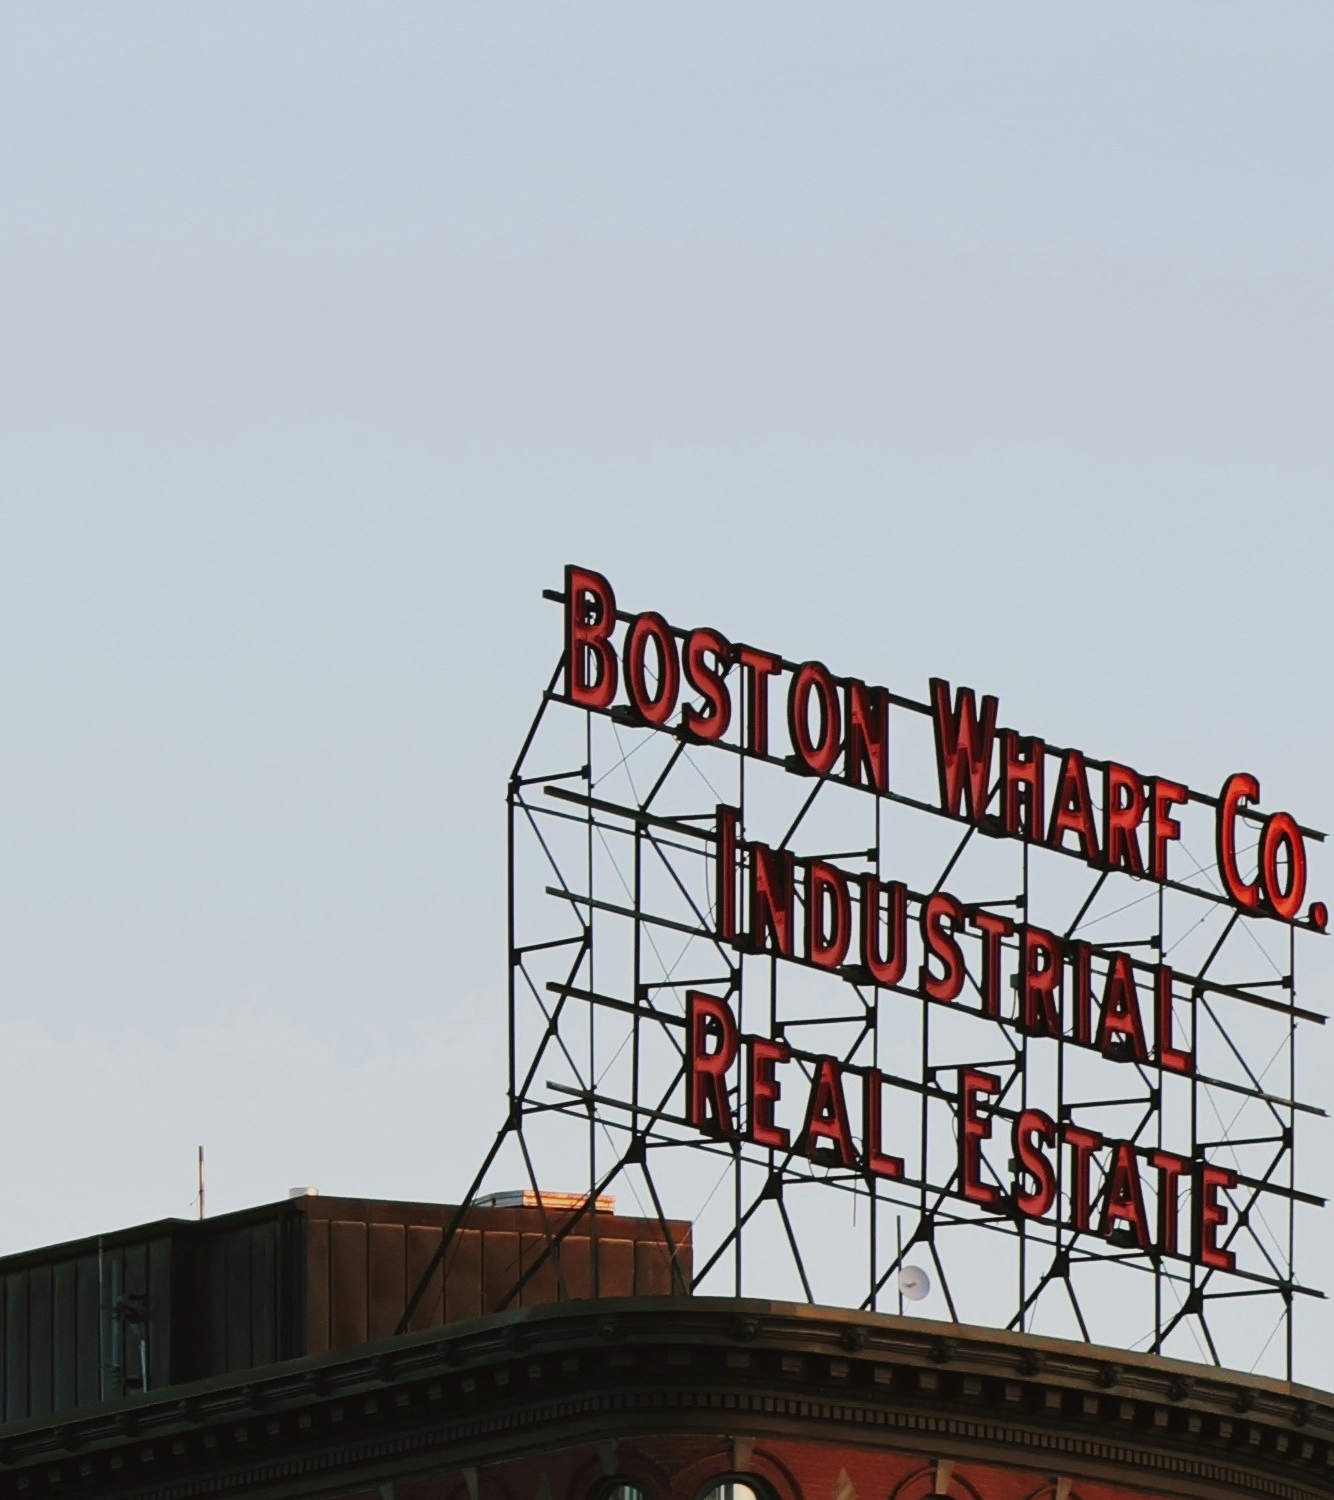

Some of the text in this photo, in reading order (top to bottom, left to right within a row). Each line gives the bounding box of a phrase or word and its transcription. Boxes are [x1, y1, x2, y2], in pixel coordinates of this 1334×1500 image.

[564, 565, 1328, 929] BOSTON WHARF CO.
[716, 804, 1195, 1074] INDUSTRIAL
[685, 990, 1238, 1272] REAL ESTATE
